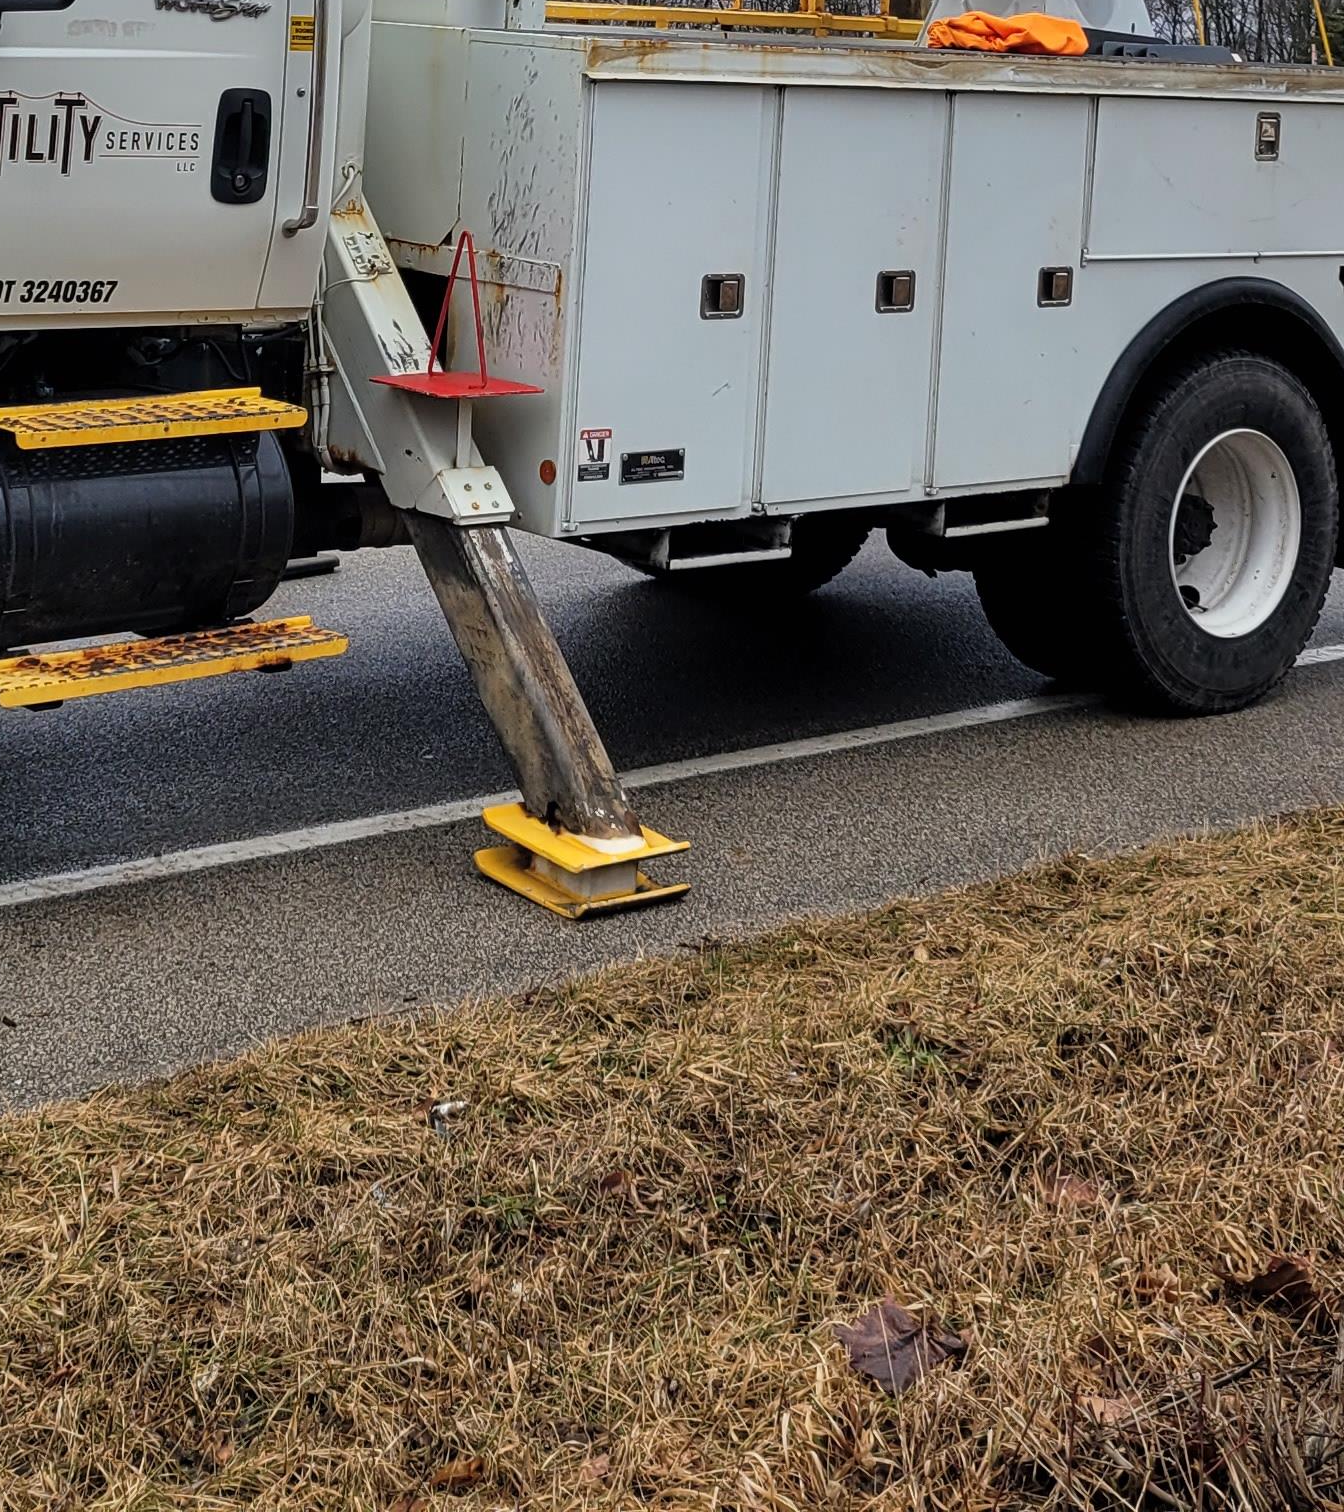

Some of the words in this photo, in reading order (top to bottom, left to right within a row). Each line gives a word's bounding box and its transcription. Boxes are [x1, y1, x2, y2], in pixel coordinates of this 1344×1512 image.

[105, 131, 200, 152] SERVICES
[176, 161, 196, 172] LLC
[19, 279, 118, 304] 3240367
